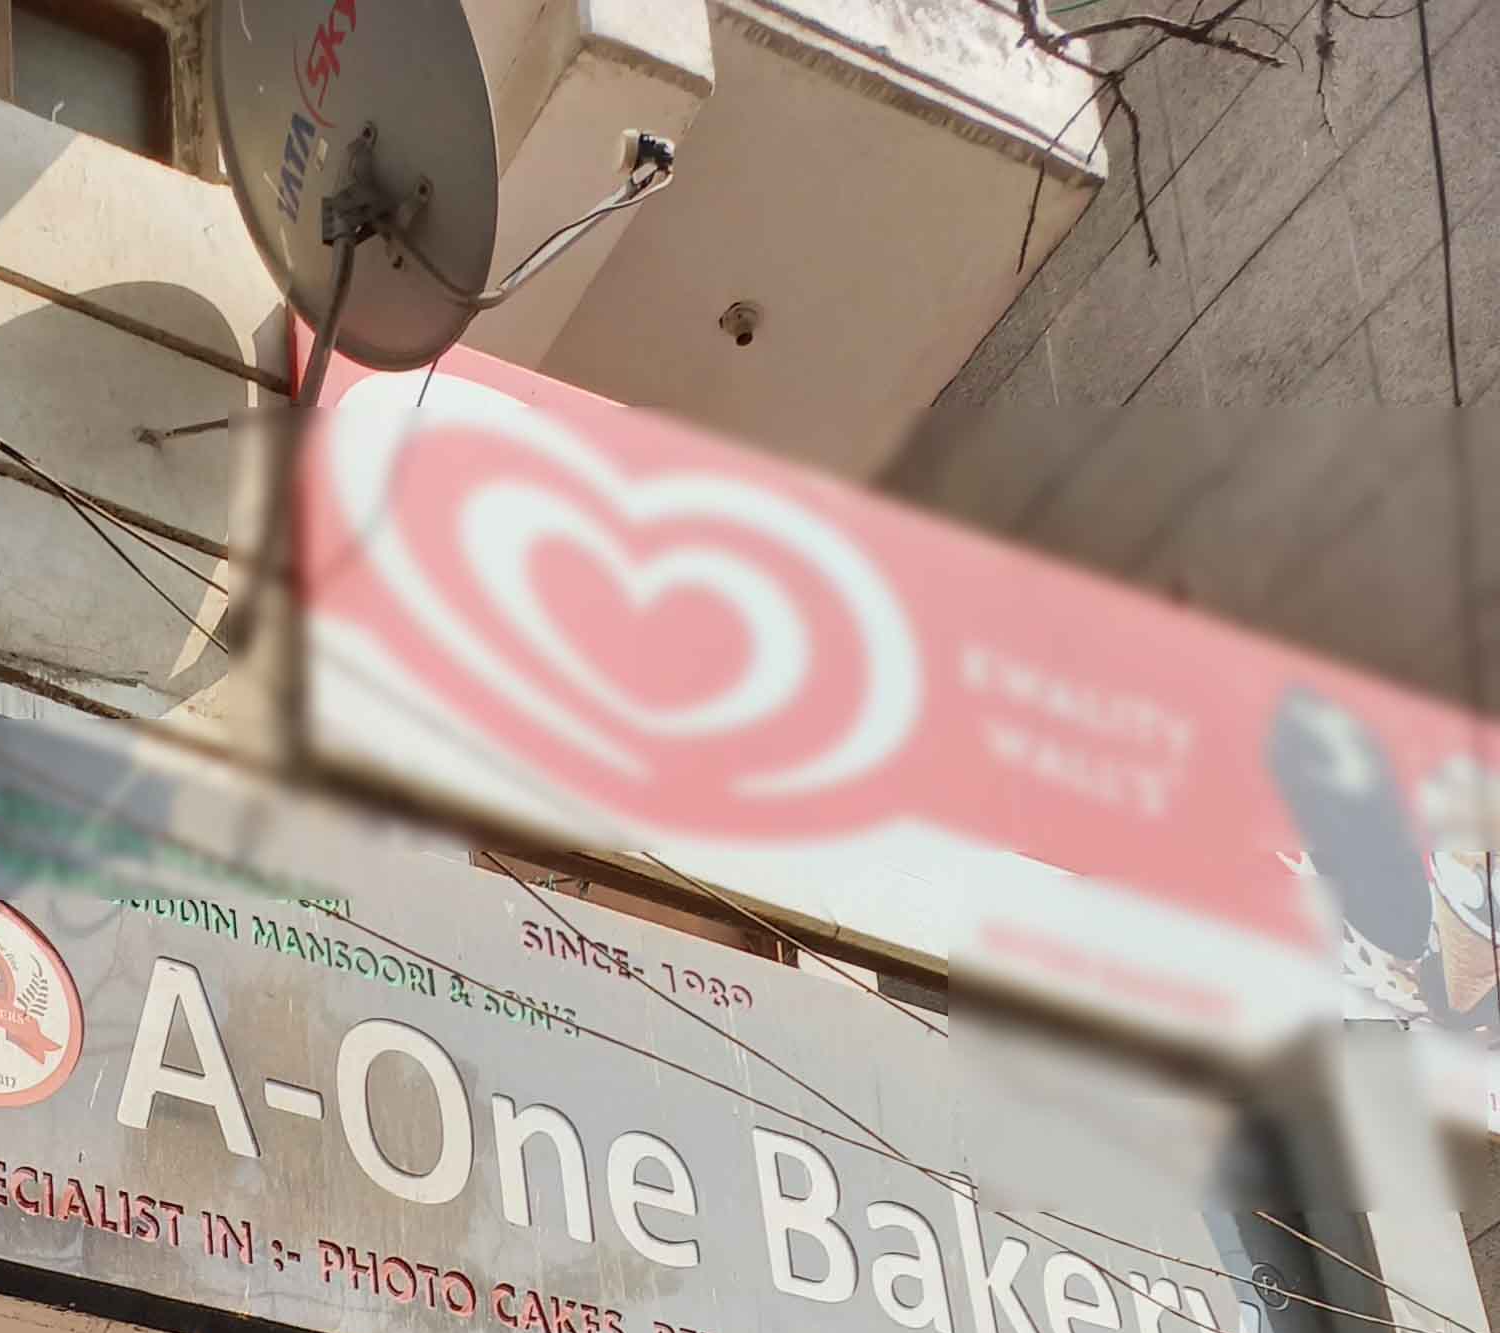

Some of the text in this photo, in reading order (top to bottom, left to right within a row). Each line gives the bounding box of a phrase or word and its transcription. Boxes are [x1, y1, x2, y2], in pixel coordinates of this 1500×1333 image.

[251, 915, 437, 998] MANSOORI
[450, 977, 474, 1007] &
[116, 954, 701, 1270] A-One
[201, 1210, 253, 1265] IN
[318, 1238, 478, 1320] PHOTO
